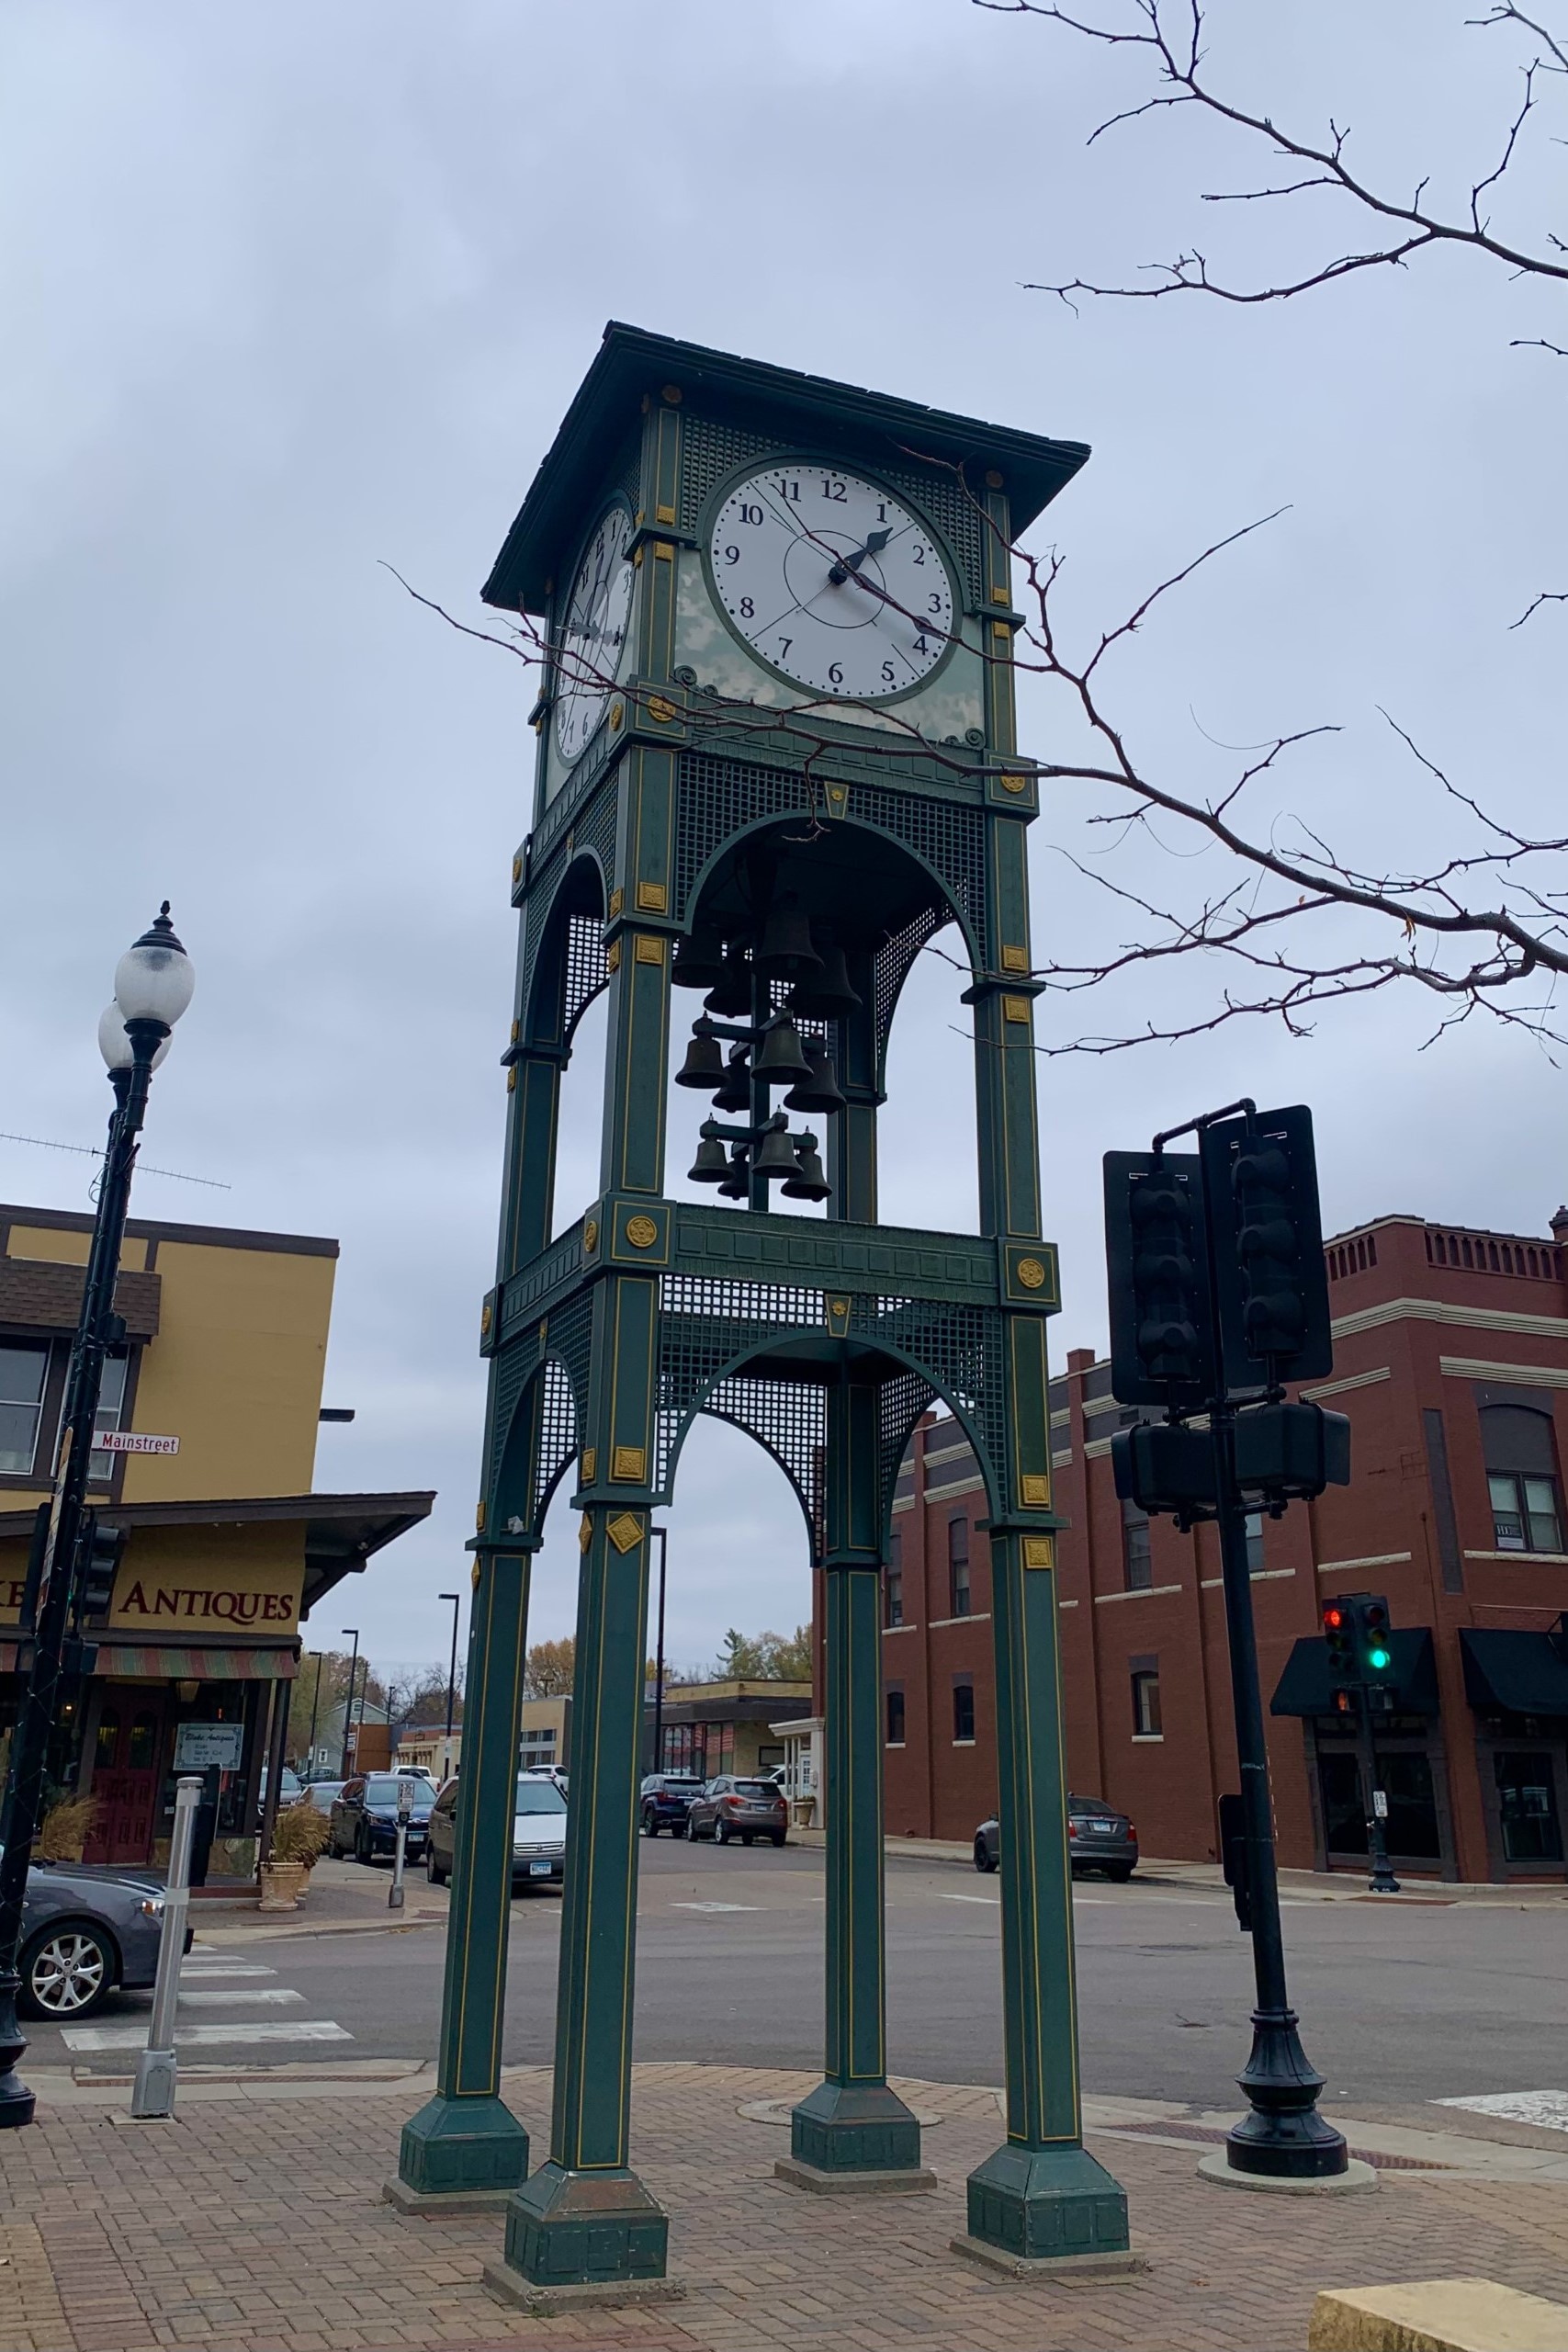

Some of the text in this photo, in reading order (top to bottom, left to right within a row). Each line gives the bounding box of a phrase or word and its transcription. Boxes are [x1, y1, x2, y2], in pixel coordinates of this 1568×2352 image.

[780, 479, 802, 503] 11
[820, 480, 848, 503] 12
[739, 503, 764, 526] 10
[876, 503, 887, 524] 1
[725, 545, 740, 566] 9
[912, 545, 925, 566] 2
[739, 596, 755, 618] 8
[928, 593, 942, 614] 3
[778, 637, 794, 659] 7
[912, 634, 929, 656] 4
[829, 662, 843, 684] 6
[881, 661, 895, 682] 5
[102, 1433, 176, 1452] Mainstreet
[118, 1580, 294, 1625] ANTIQUES
